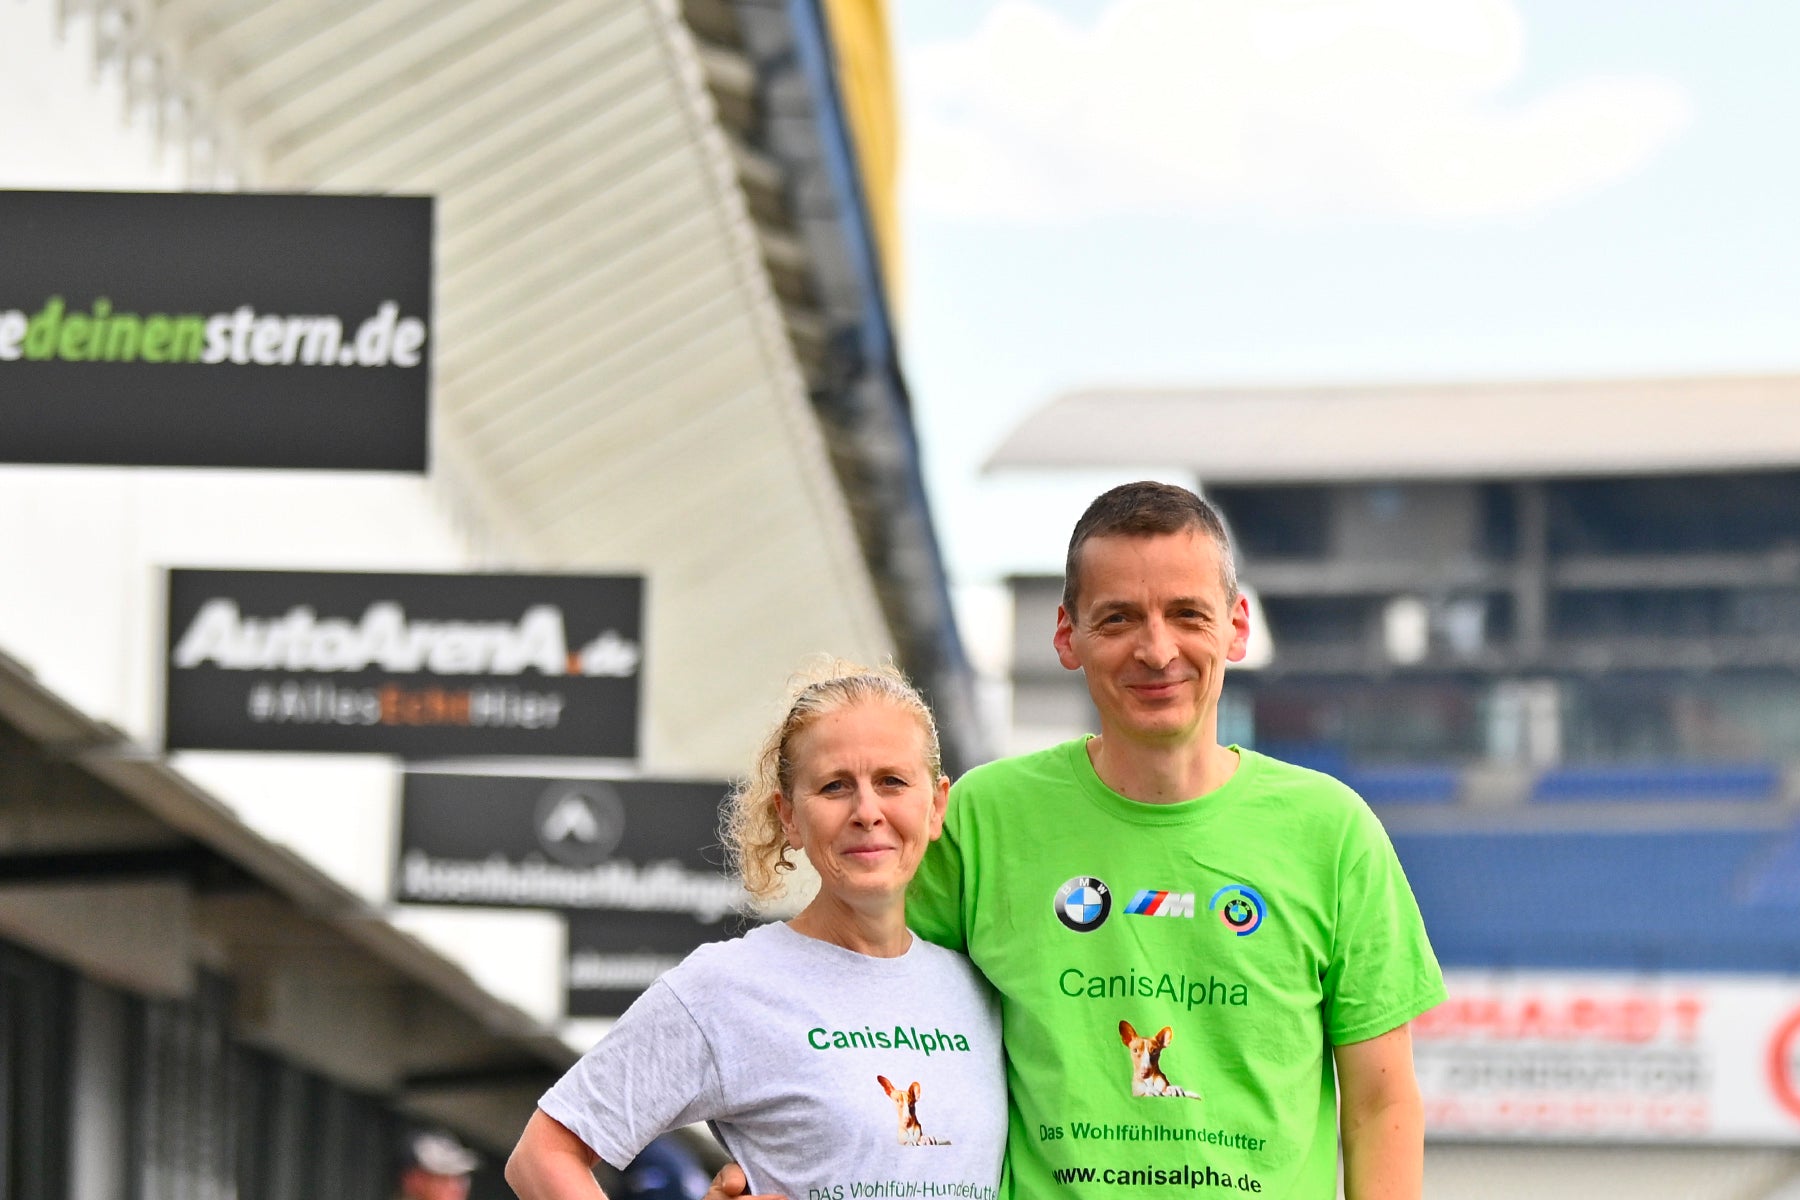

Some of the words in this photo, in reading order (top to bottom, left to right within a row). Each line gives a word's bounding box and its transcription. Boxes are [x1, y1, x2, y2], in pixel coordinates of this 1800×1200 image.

[1059, 968, 1248, 1011] CanisAlpha
[807, 1026, 971, 1056] CanisAlpha
[1039, 1124, 1064, 1142] Das
[1070, 1122, 1266, 1151] Wohlfühlhundefutter
[1052, 1165, 1262, 1193] www.canisalpha.de
